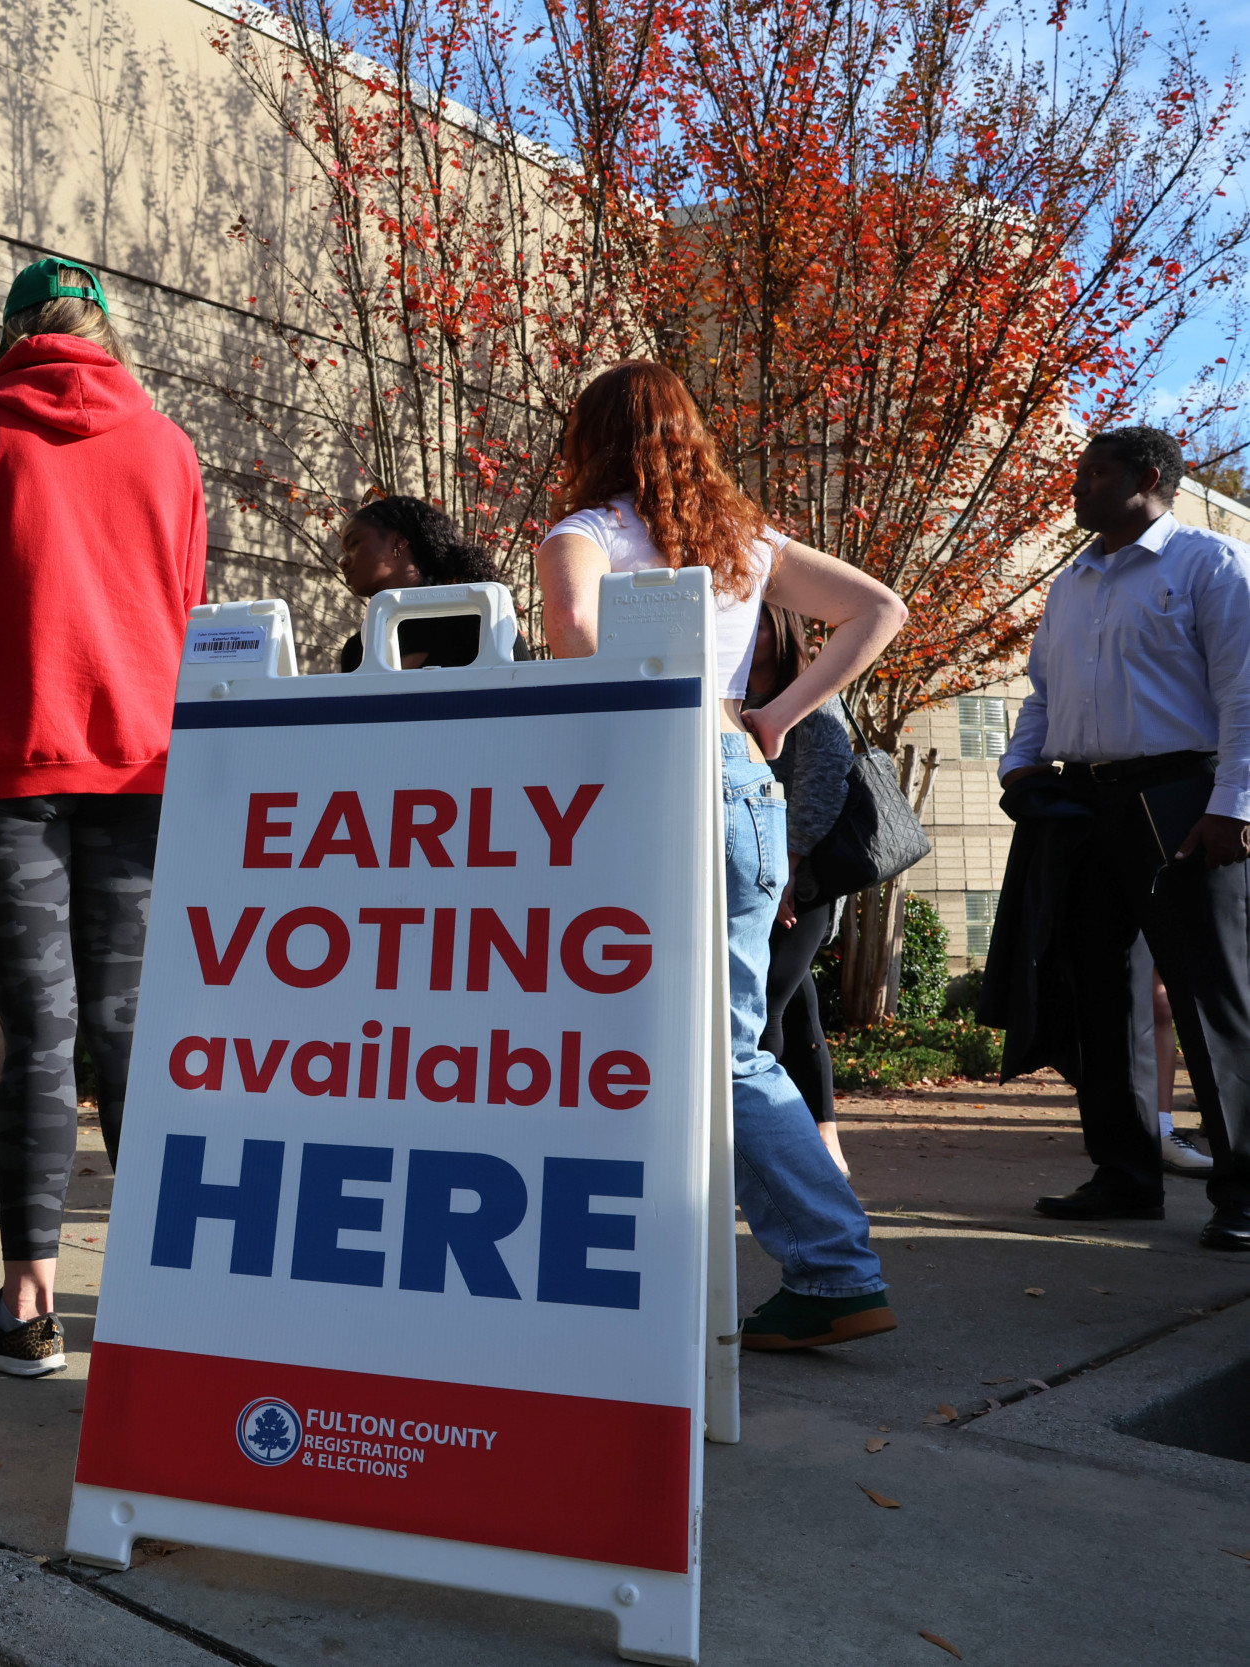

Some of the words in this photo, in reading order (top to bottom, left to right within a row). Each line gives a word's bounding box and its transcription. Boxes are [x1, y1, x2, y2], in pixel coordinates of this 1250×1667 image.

[244, 784, 604, 869] EARLY
[187, 907, 651, 993] VOTING
[170, 1021, 651, 1110] available
[151, 1134, 644, 1310] HERE
[301, 1451, 314, 1466] &
[317, 1453, 408, 1479] ELECTIONS
[304, 1434, 425, 1463] REGISTRATION
[306, 1408, 395, 1438] FULTON
[400, 1420, 498, 1450] COUNTY
